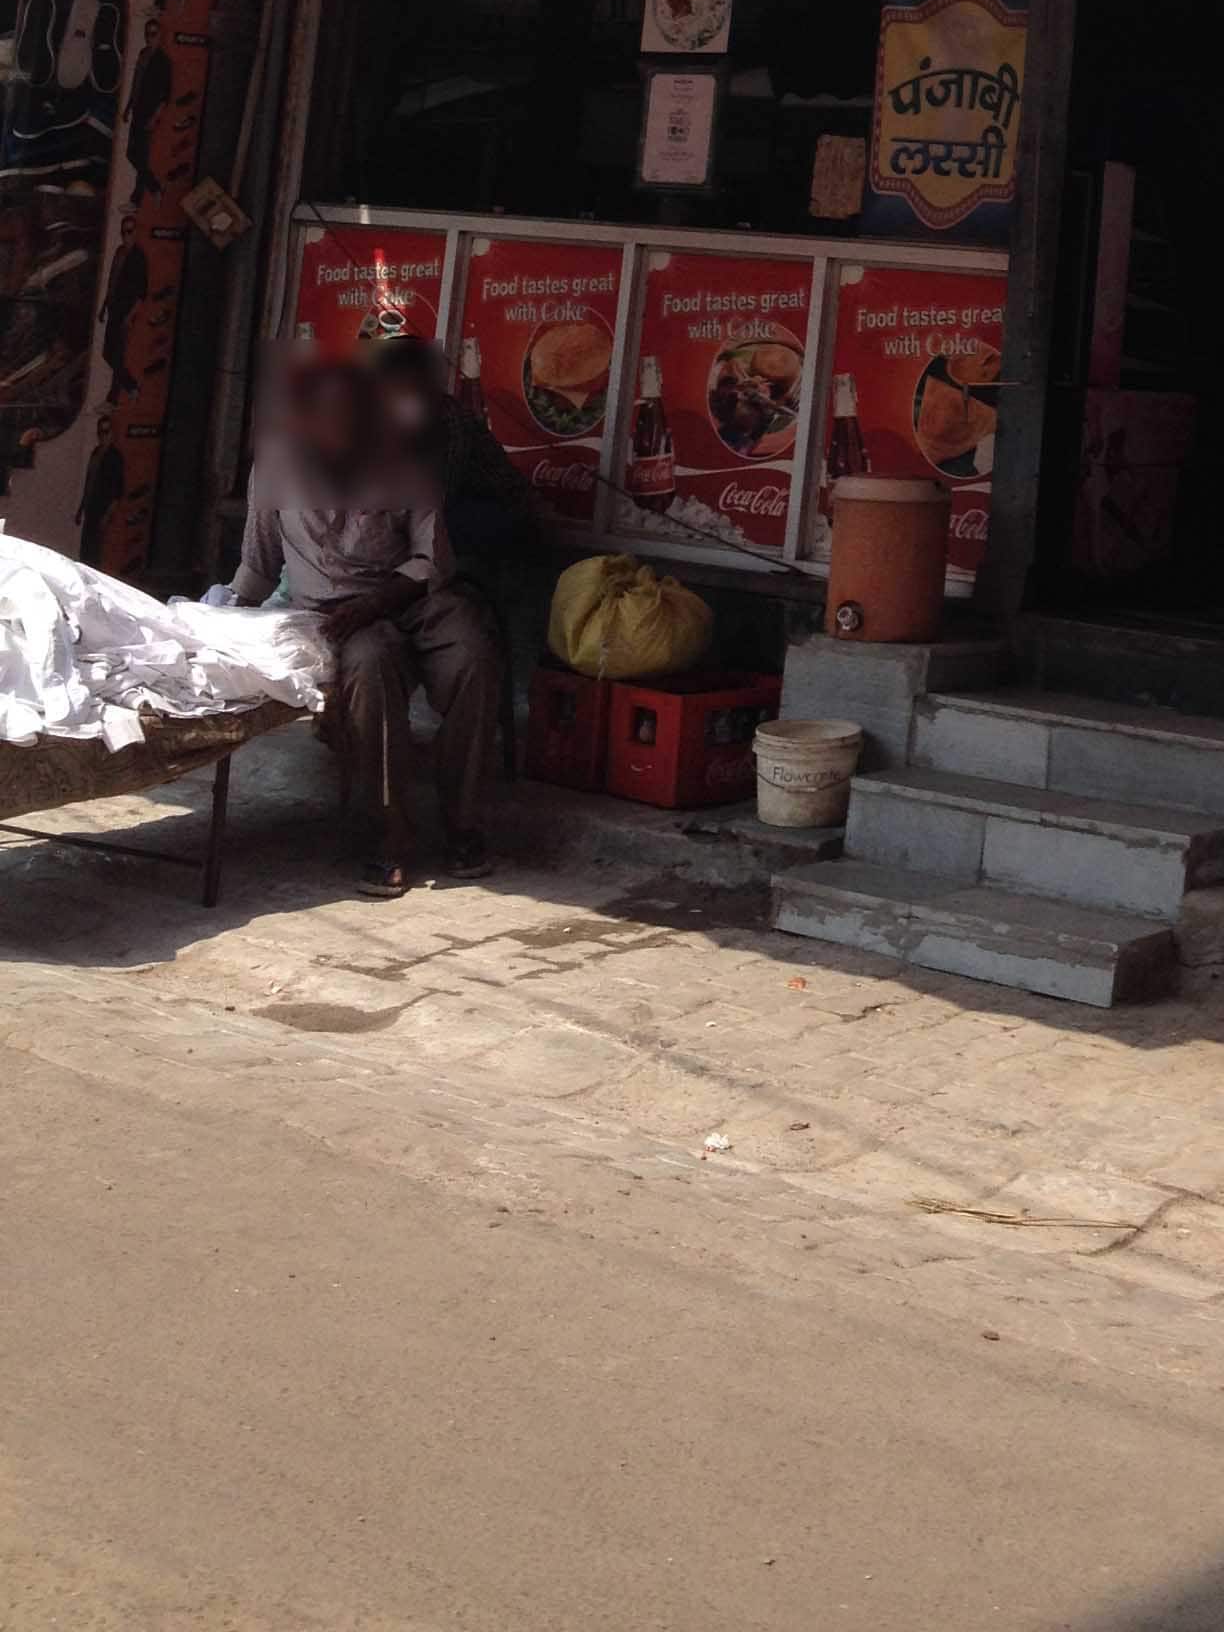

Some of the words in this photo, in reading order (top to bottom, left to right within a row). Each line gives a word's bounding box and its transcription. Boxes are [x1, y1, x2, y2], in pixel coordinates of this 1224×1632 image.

[888, 56, 1019, 129] पंजाबी
[317, 259, 352, 286] Food
[354, 261, 397, 281] tastes
[401, 258, 440, 280] great
[337, 287, 368, 305] with
[372, 285, 414, 308] Coke
[482, 274, 518, 301] Food
[522, 274, 569, 295] tastes
[572, 272, 614, 296] great
[504, 303, 537, 321] with
[540, 301, 588, 321] Coke
[663, 290, 700, 317] Food
[705, 290, 757, 312] tastes
[760, 288, 805, 313] great
[688, 319, 721, 340] with
[727, 318, 774, 339] Coke
[856, 306, 898, 333] Food
[903, 305, 957, 327] tastes
[961, 306, 1006, 329] grea
[884, 334, 921, 356] with
[926, 333, 979, 356] Coke
